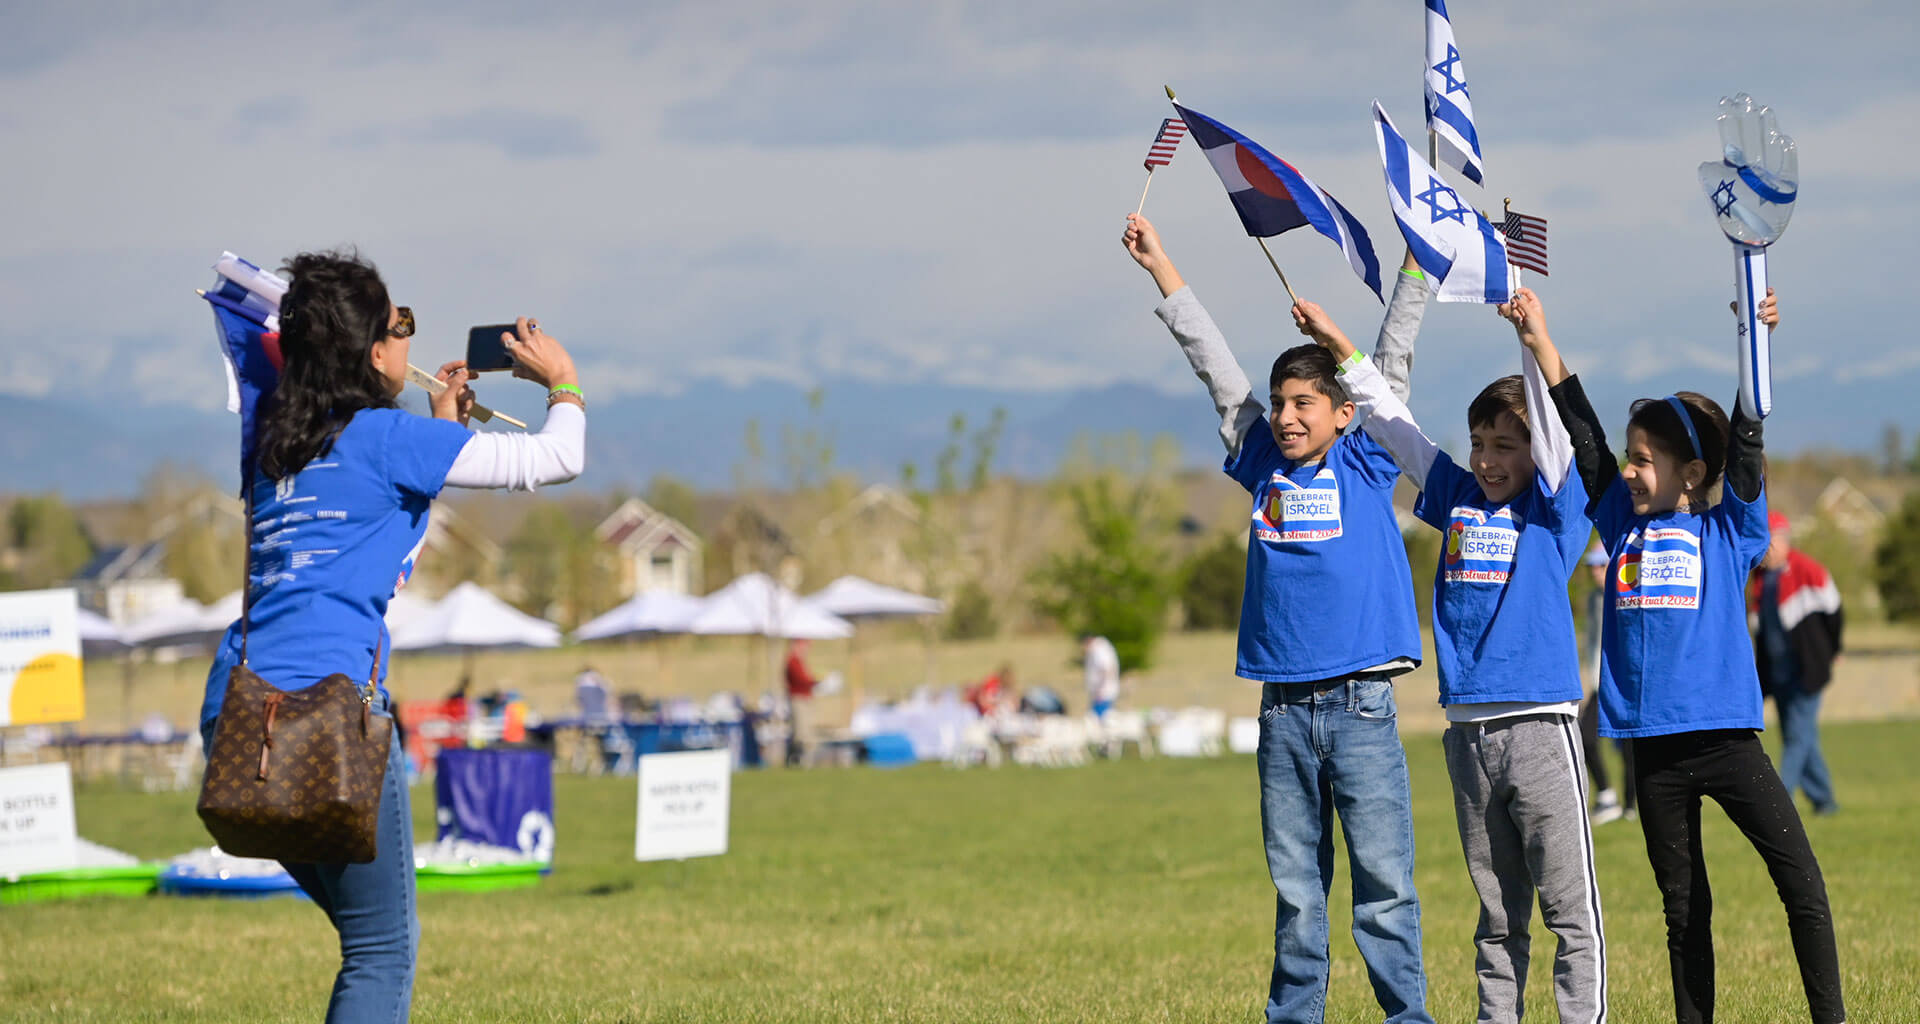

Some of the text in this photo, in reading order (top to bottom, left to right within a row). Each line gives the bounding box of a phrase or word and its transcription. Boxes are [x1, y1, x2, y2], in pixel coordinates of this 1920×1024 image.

[1285, 493, 1333, 502] CELEBRATE
[1316, 526, 1340, 538] 2022
[1667, 594, 1696, 606] 2022
